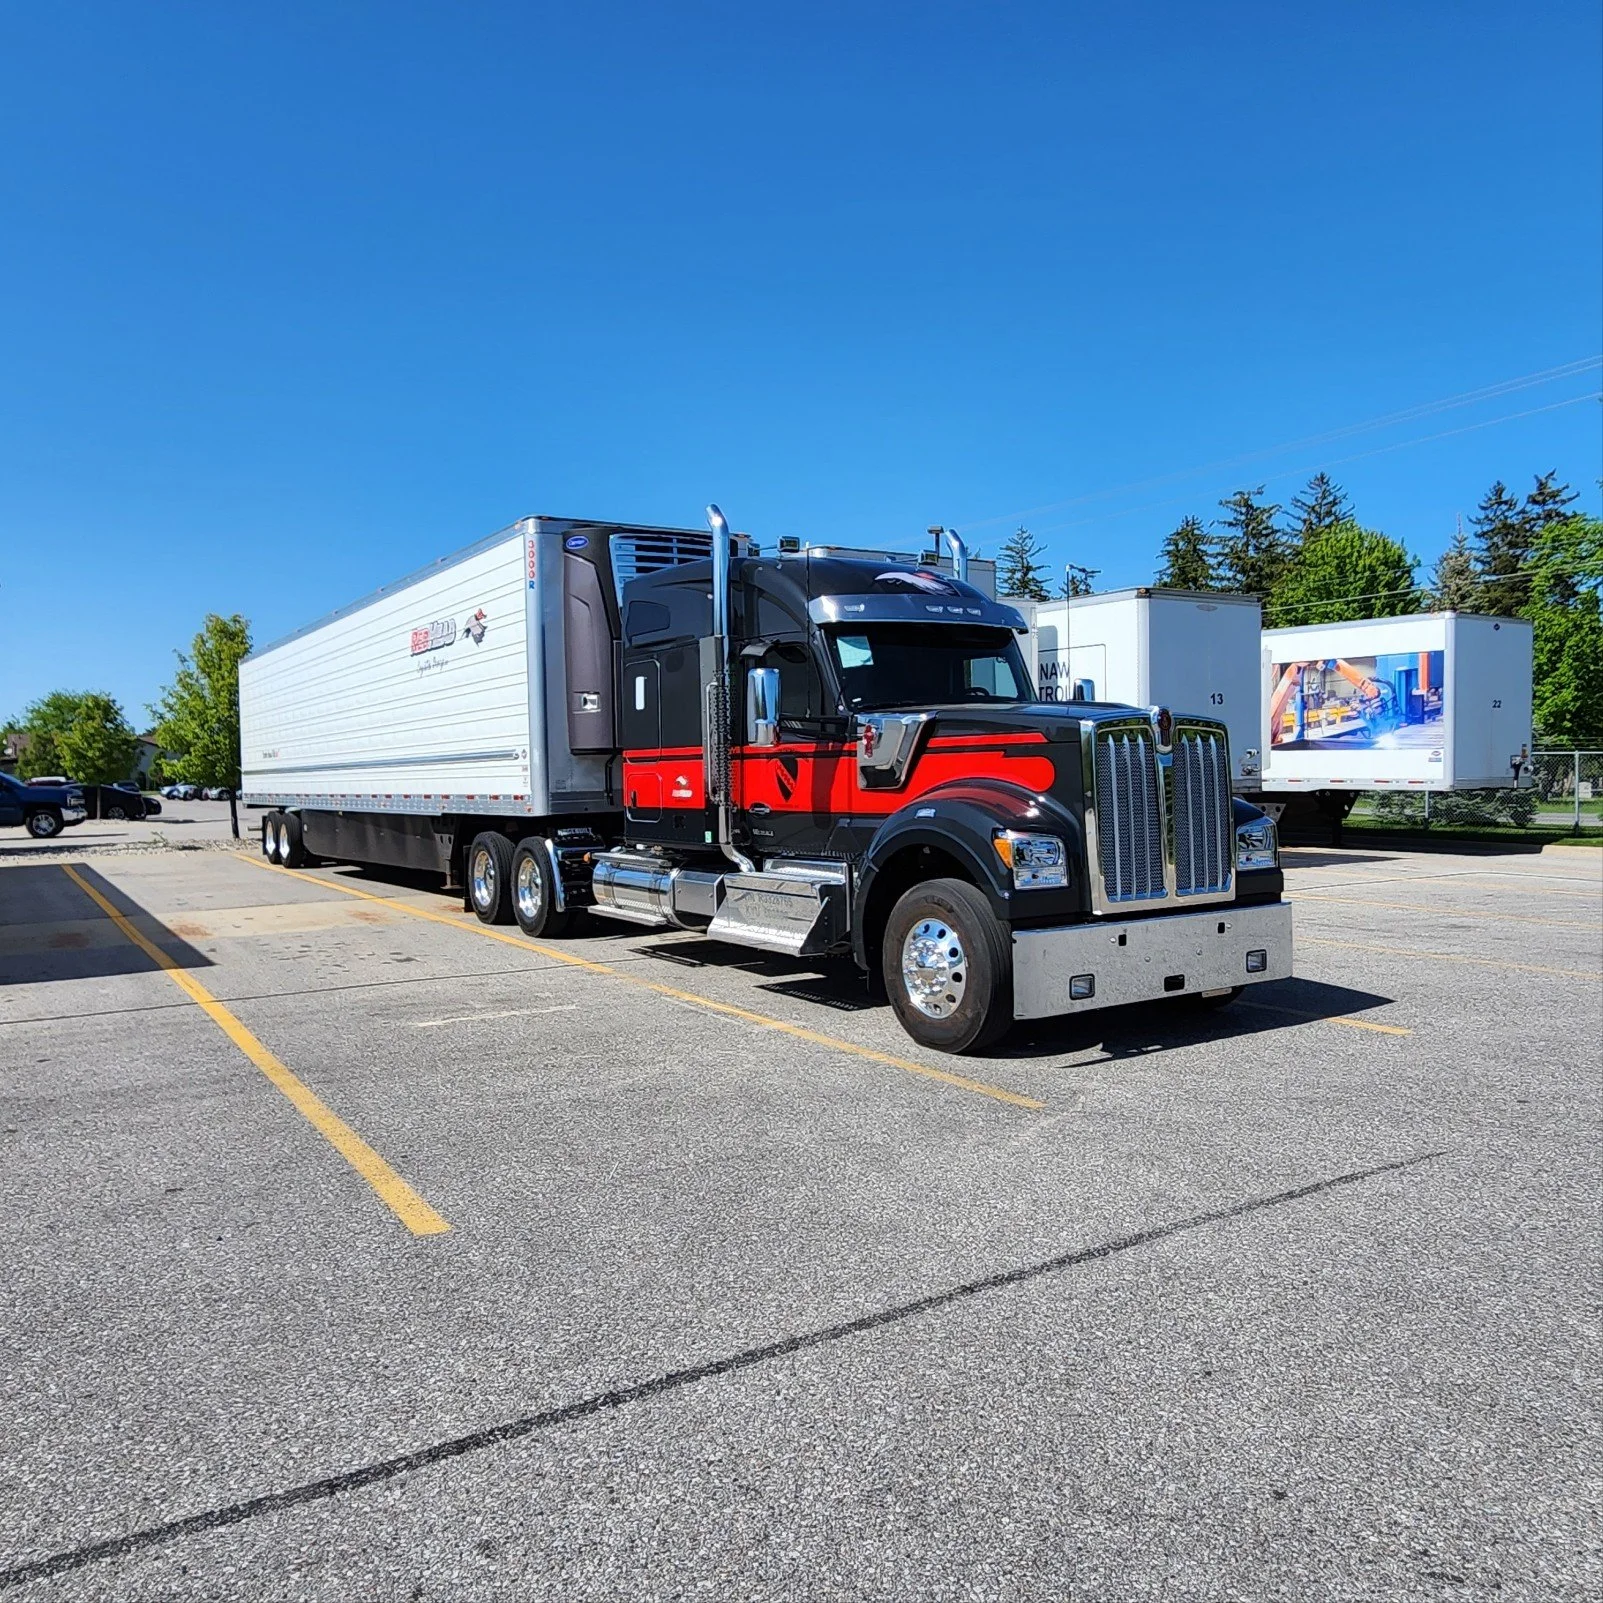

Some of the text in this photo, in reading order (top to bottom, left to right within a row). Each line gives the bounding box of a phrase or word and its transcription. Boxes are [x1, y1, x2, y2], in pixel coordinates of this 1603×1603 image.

[528, 540, 536, 590] 3000R
[1210, 692, 1224, 705] 13
[1492, 699, 1502, 709] 22
